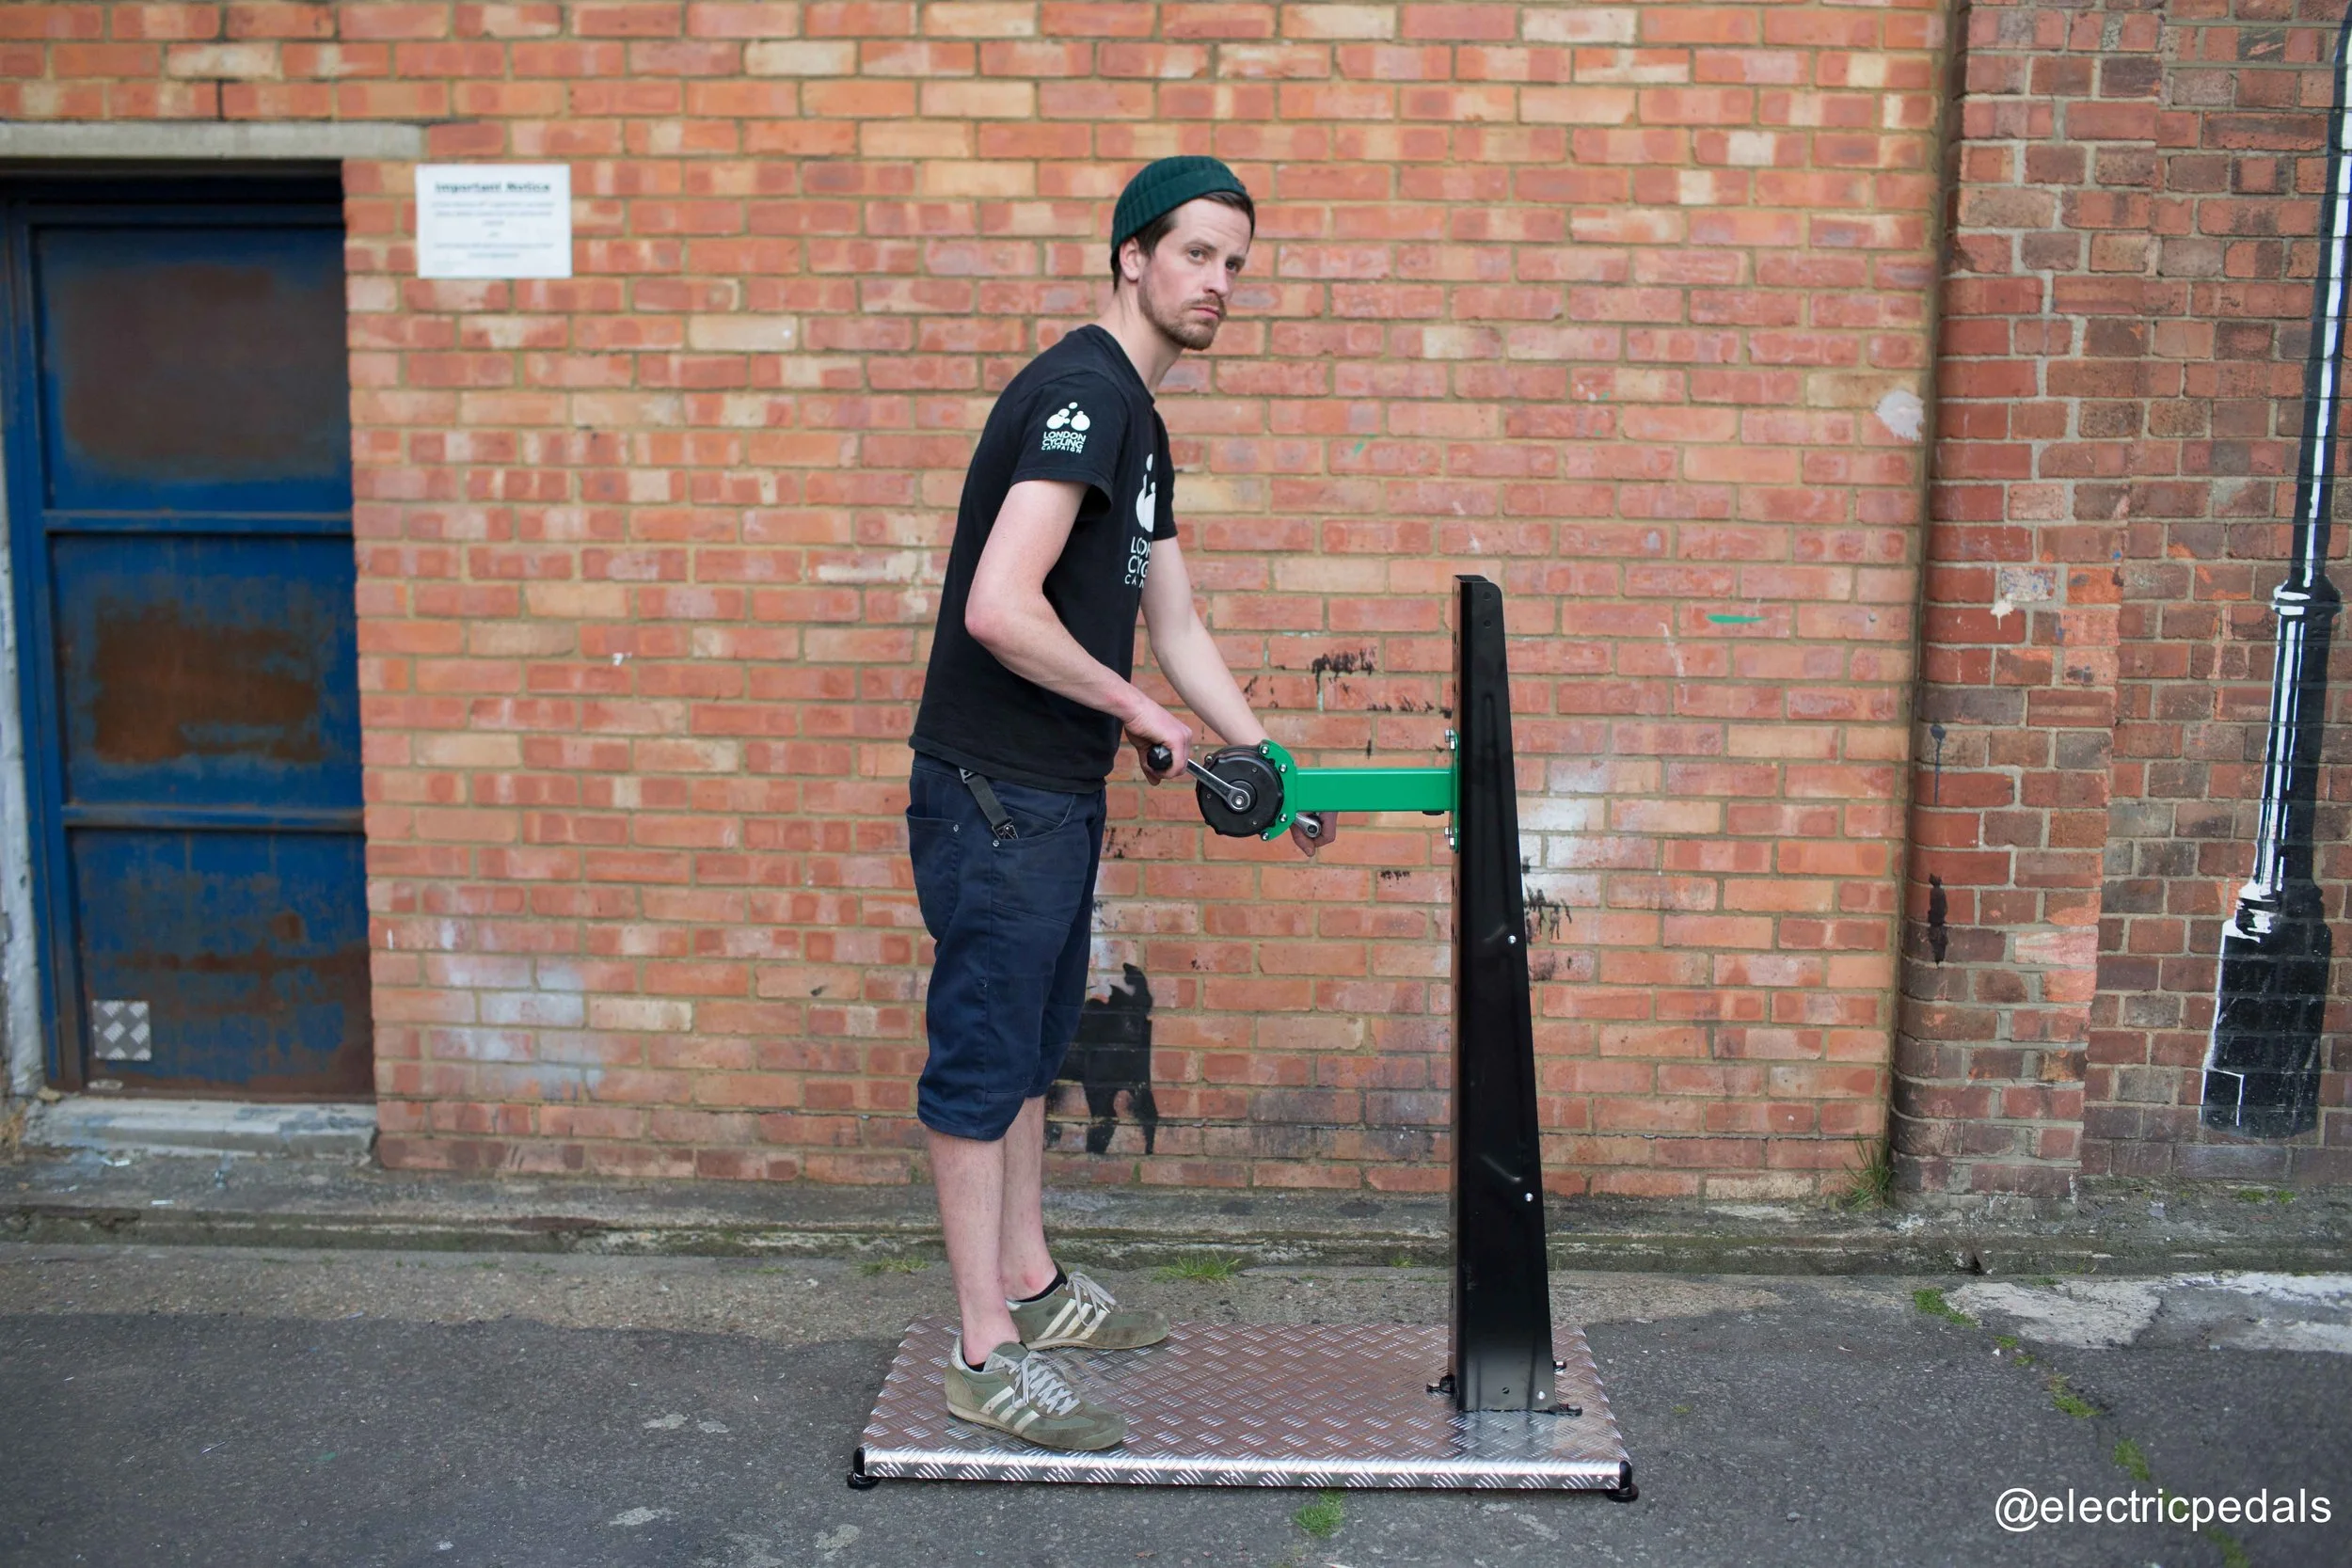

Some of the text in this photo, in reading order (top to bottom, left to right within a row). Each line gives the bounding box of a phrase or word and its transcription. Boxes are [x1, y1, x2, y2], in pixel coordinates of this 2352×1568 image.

[435, 182, 550, 194] Important Notice
[1043, 431, 1087, 442] LONDON
[1041, 445, 1082, 453] CAMPAIGN
[1042, 438, 1085, 450] CYCLING
